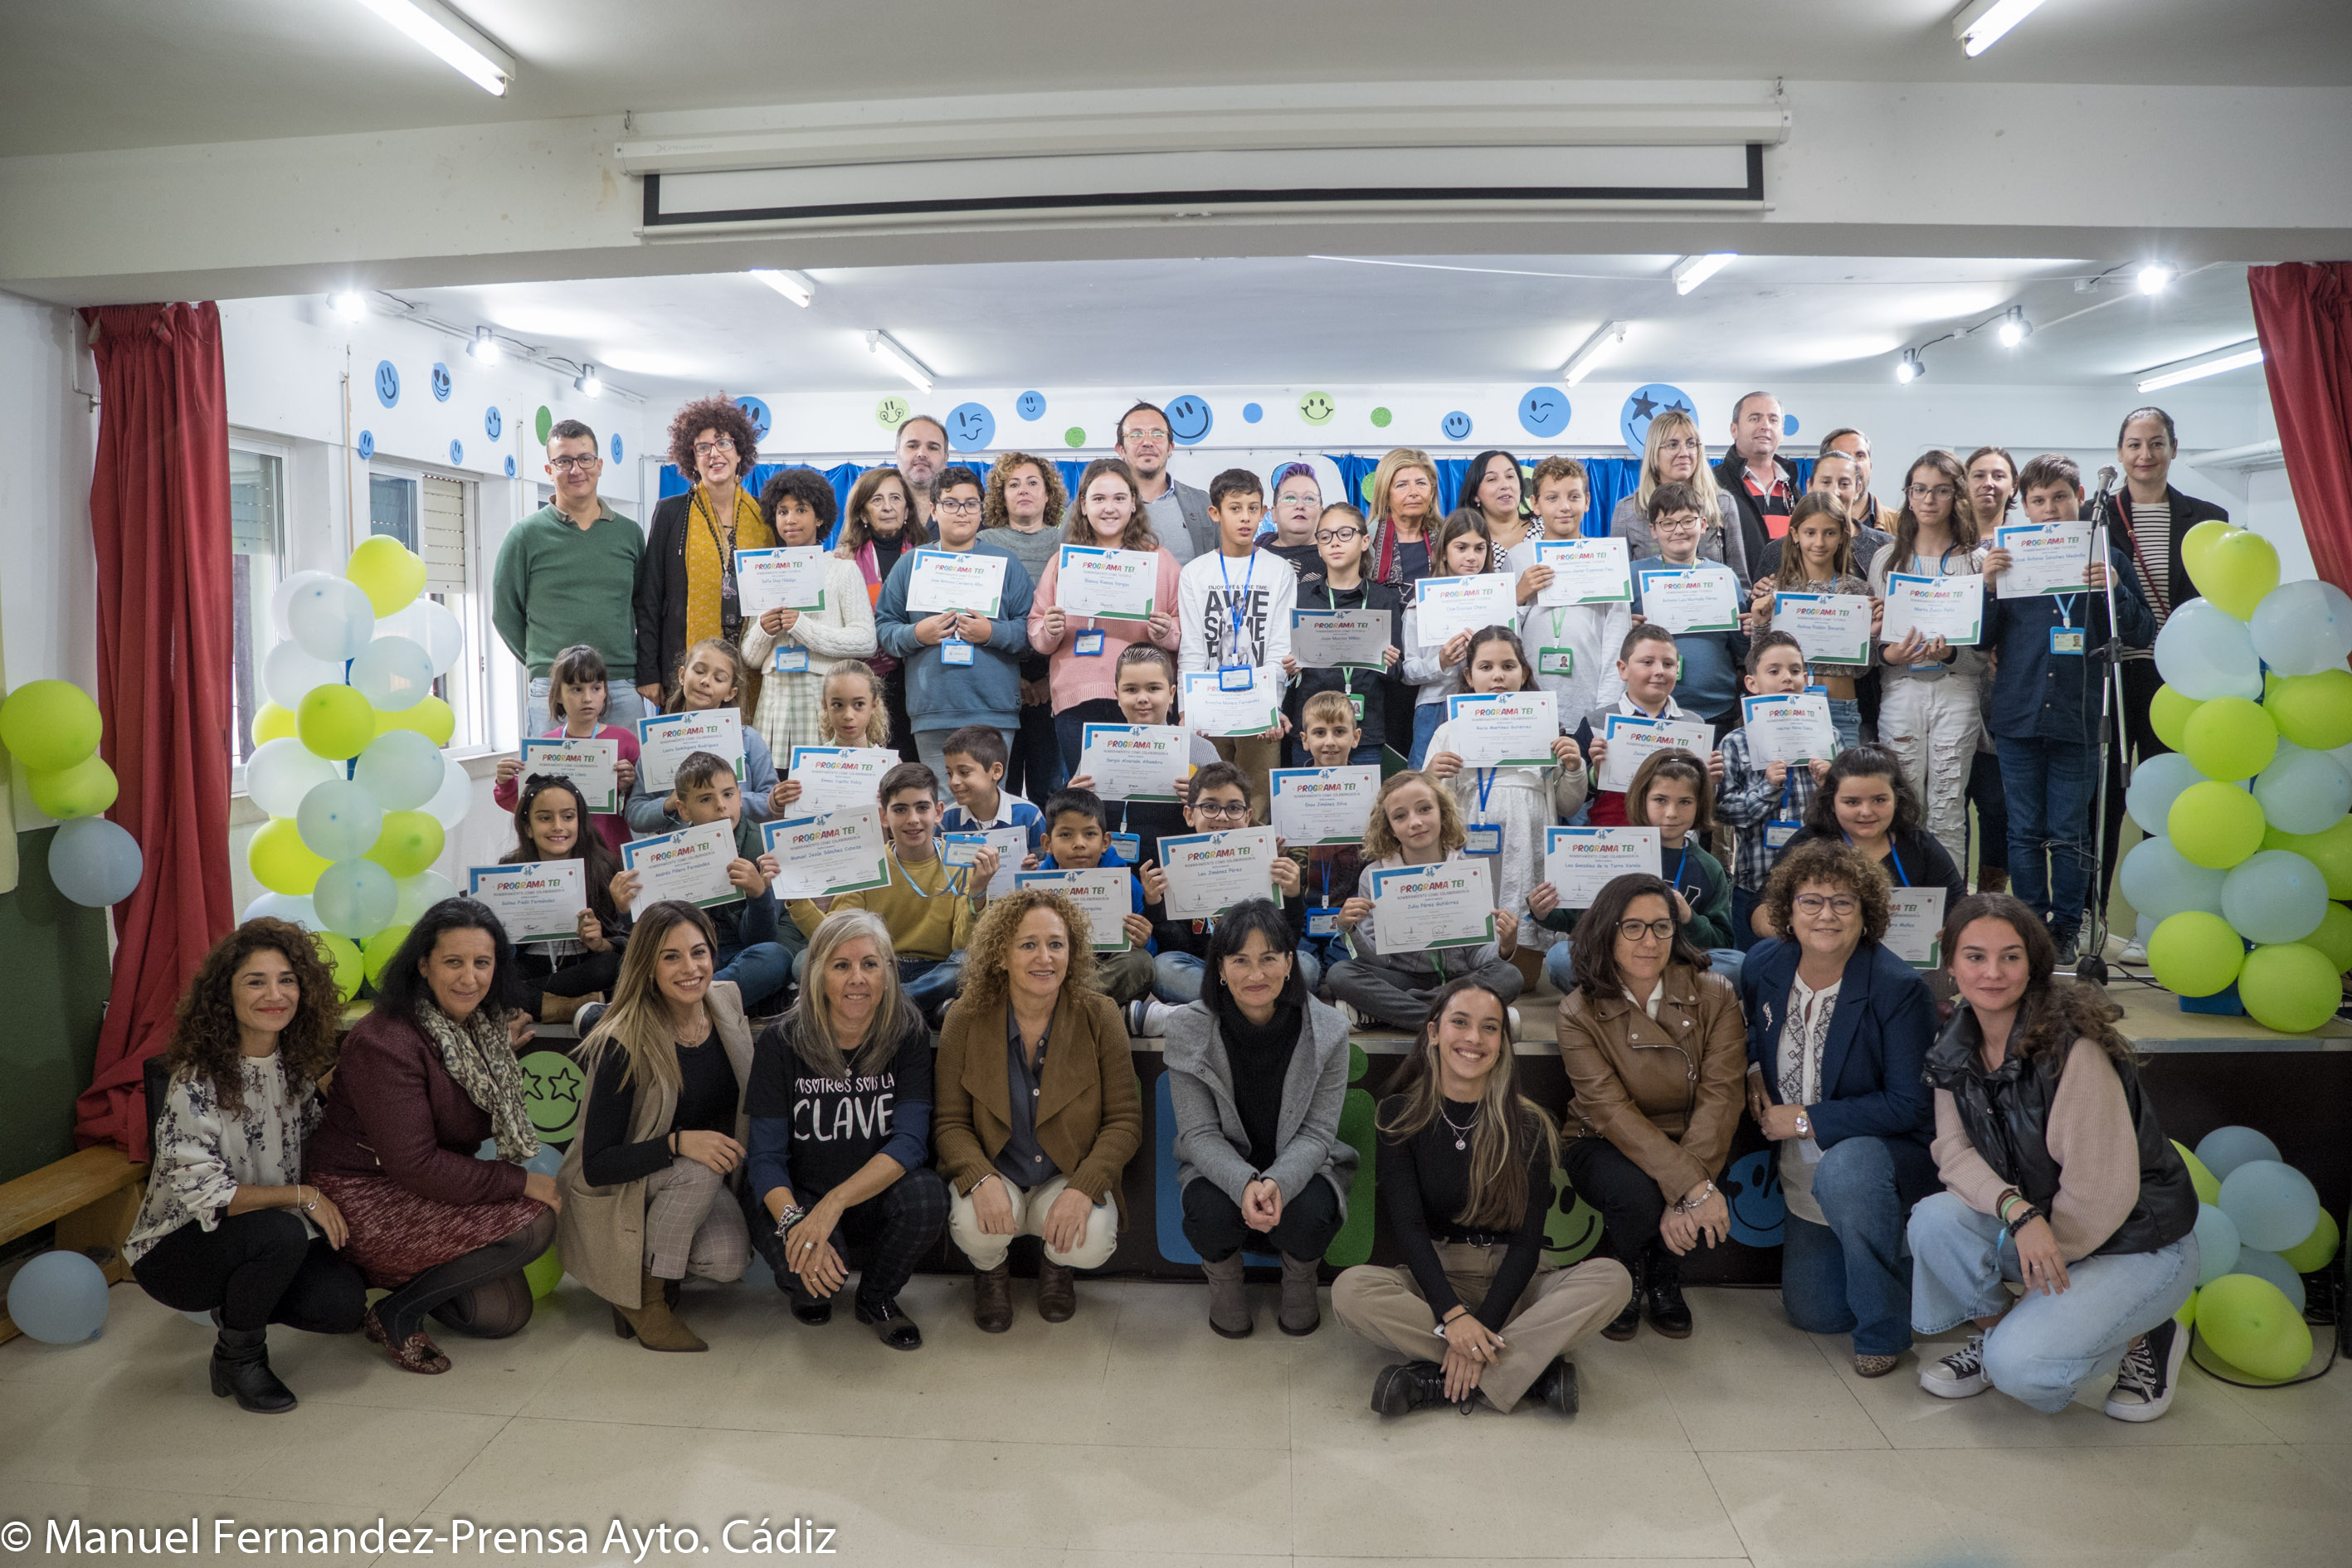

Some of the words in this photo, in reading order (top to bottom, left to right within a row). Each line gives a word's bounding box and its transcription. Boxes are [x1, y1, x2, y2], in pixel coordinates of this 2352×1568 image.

[2021, 538, 2065, 547] PROGRAMA
[755, 562, 791, 570] PROGRAMA
[935, 565, 971, 573] PROGRAMA
[1083, 562, 1122, 572] PROGRAMA
[1440, 590, 1479, 598] PROGRAMA
[1910, 590, 1950, 598] PROGRAMA
[1205, 591, 1269, 616] AWE
[1474, 708, 1519, 716] PROGRAMA
[662, 727, 704, 738] PROGRAMA
[1108, 740, 1151, 749] PROGRAMA
[1630, 733, 1674, 744] PROGRAMA
[1678, 738, 1689, 747] TEI
[543, 754, 582, 762] PROGRAMA
[816, 762, 858, 771] PROGRAMA
[861, 763, 873, 772] TEI
[1298, 784, 1342, 793] PROGRAMA
[793, 829, 840, 845] PROGRAMA
[842, 826, 855, 835] TEI
[650, 845, 695, 863] PROGRAMA
[698, 842, 709, 852] TEI
[997, 845, 1008, 854] TEI
[1572, 845, 1619, 853] PROGRAMA
[1187, 848, 1235, 861] PROGRAMA
[1238, 847, 1250, 855] TEI
[498, 879, 545, 890] PROGRAMA
[1400, 881, 1449, 894] PROGRAMA
[1451, 879, 1464, 889] TEI
[1093, 887, 1104, 895] TEI
[881, 1072, 895, 1089] LA
[794, 1093, 894, 1142] CLAVE
